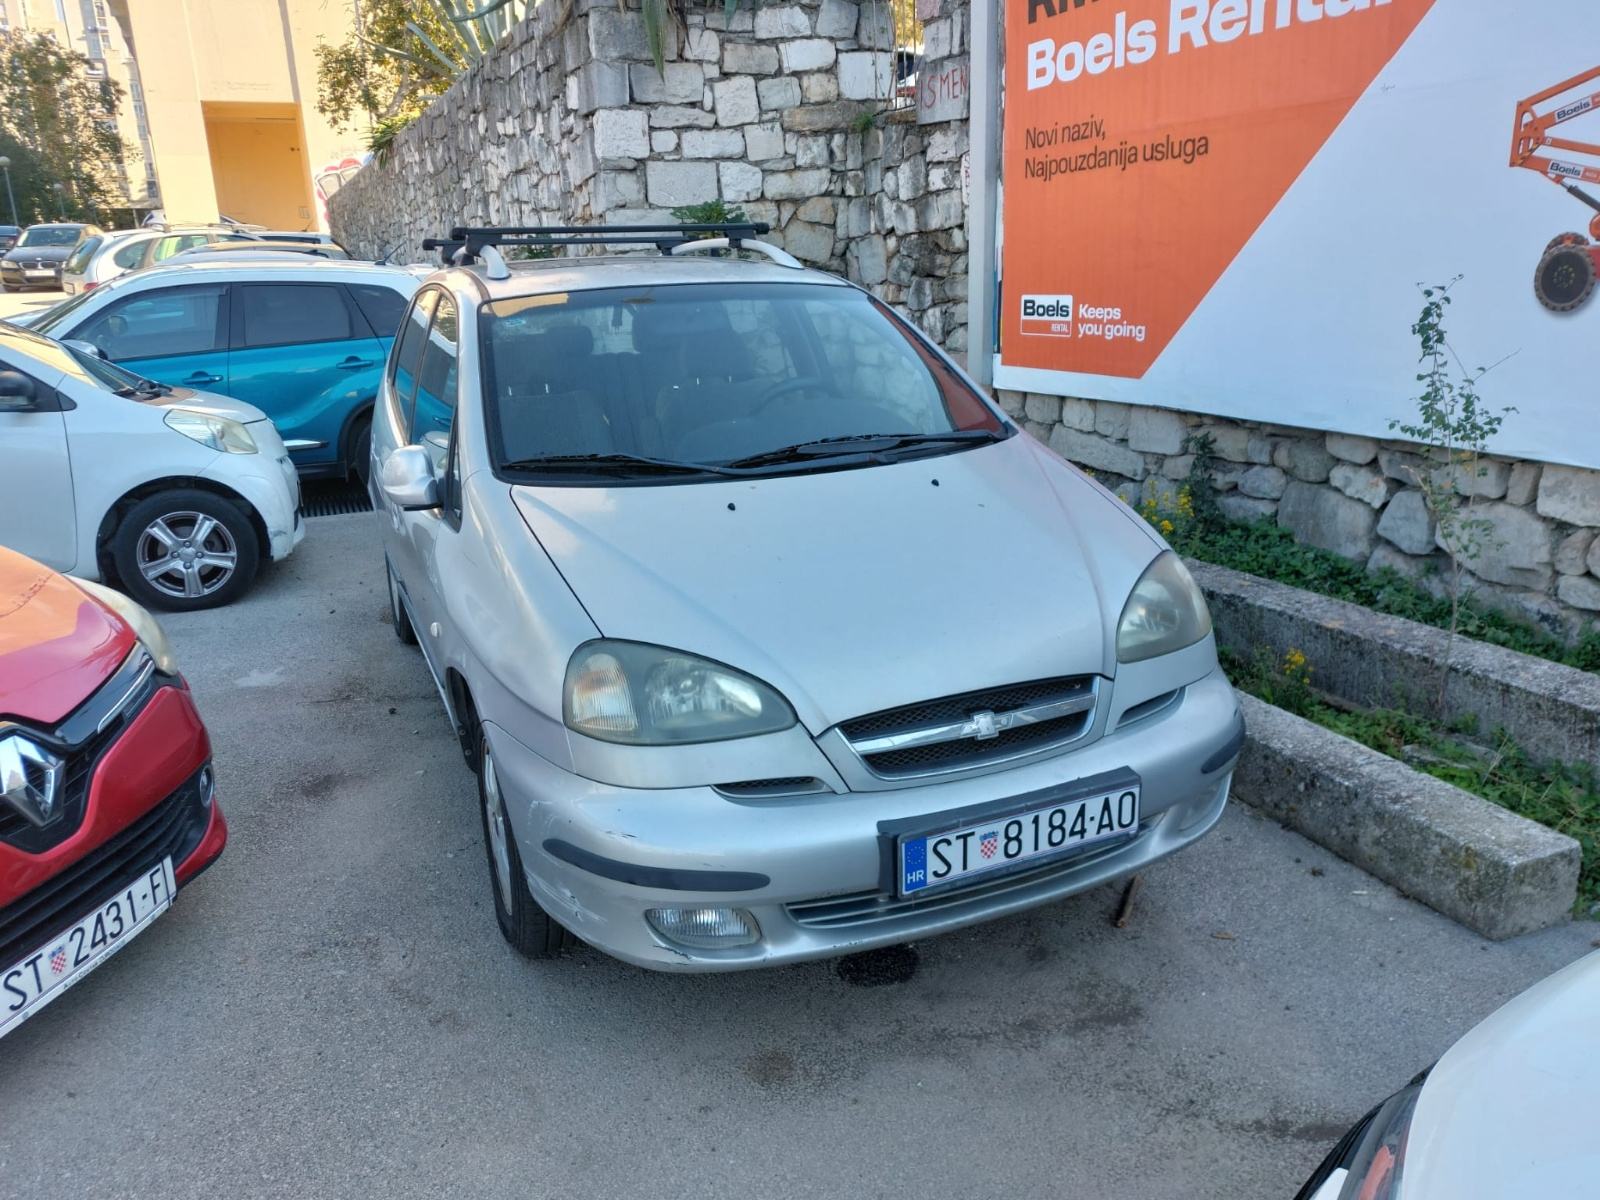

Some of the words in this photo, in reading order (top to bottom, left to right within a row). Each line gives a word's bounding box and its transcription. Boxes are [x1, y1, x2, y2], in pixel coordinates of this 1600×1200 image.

[1028, 11, 1157, 91] Boels
[1557, 100, 1591, 119] Boels
[1025, 122, 1058, 150] Novi
[1061, 114, 1106, 143] naziv,
[1024, 141, 1138, 182] Najpouzdanija
[1142, 134, 1209, 164] usluga
[1550, 162, 1581, 176] Boels
[1023, 299, 1070, 317] Boels
[1078, 304, 1121, 322] Keeps
[1078, 323, 1102, 338] you
[1105, 320, 1146, 342] going
[932, 831, 975, 878] ST
[907, 870, 924, 884] HR
[3, 953, 43, 1011] ST
